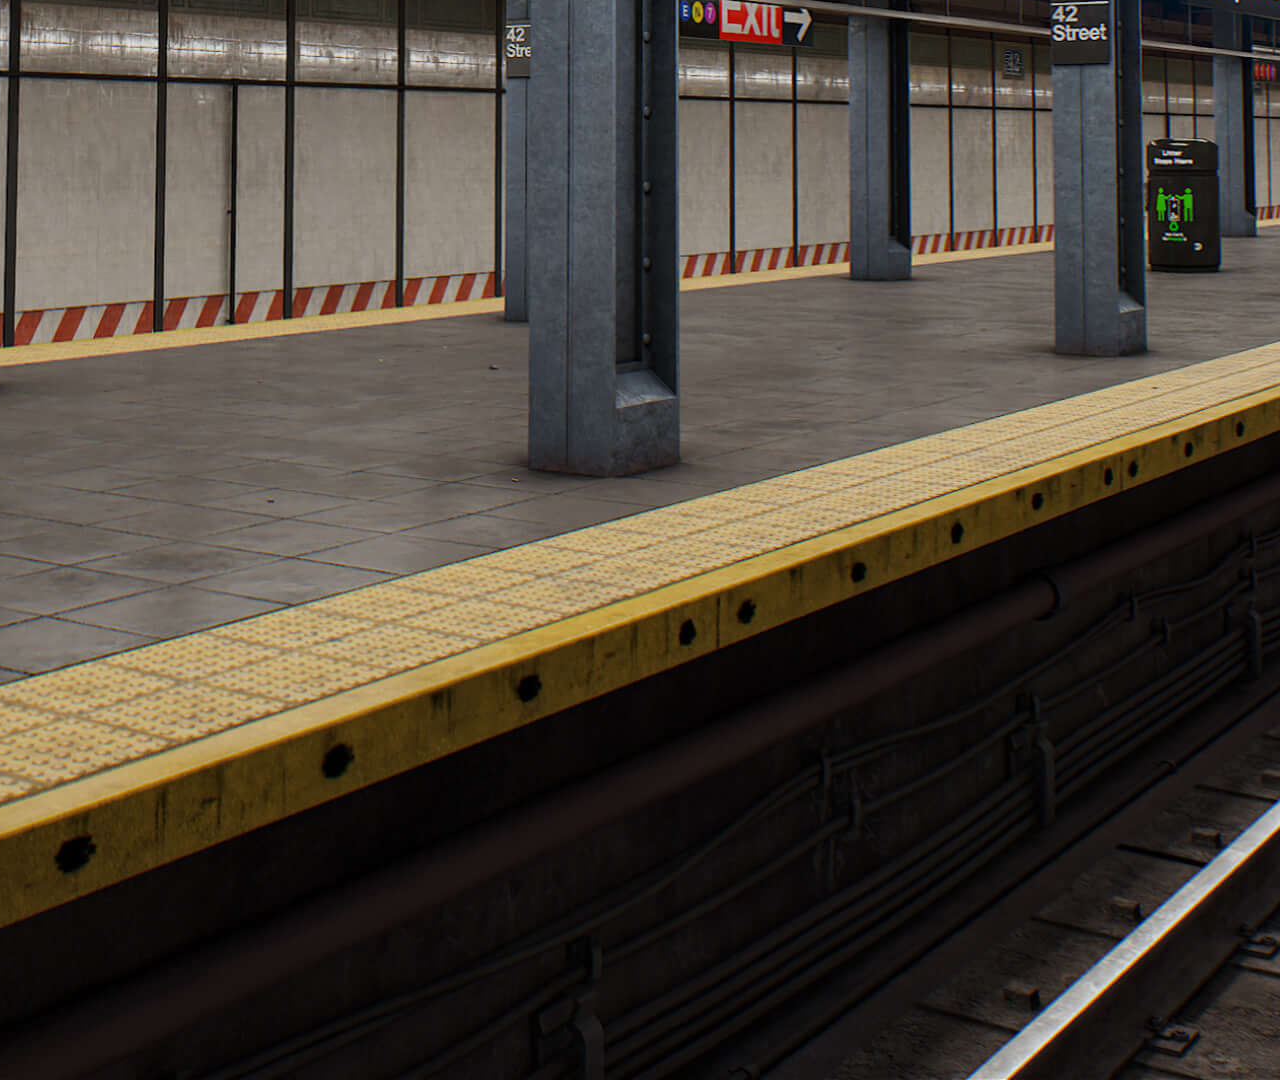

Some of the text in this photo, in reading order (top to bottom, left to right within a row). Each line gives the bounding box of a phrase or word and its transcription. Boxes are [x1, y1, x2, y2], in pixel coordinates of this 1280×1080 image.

[1051, 5, 1079, 22] 42
[506, 27, 526, 42] 42
[1052, 23, 1108, 41] Street
[506, 43, 532, 58] Stre
